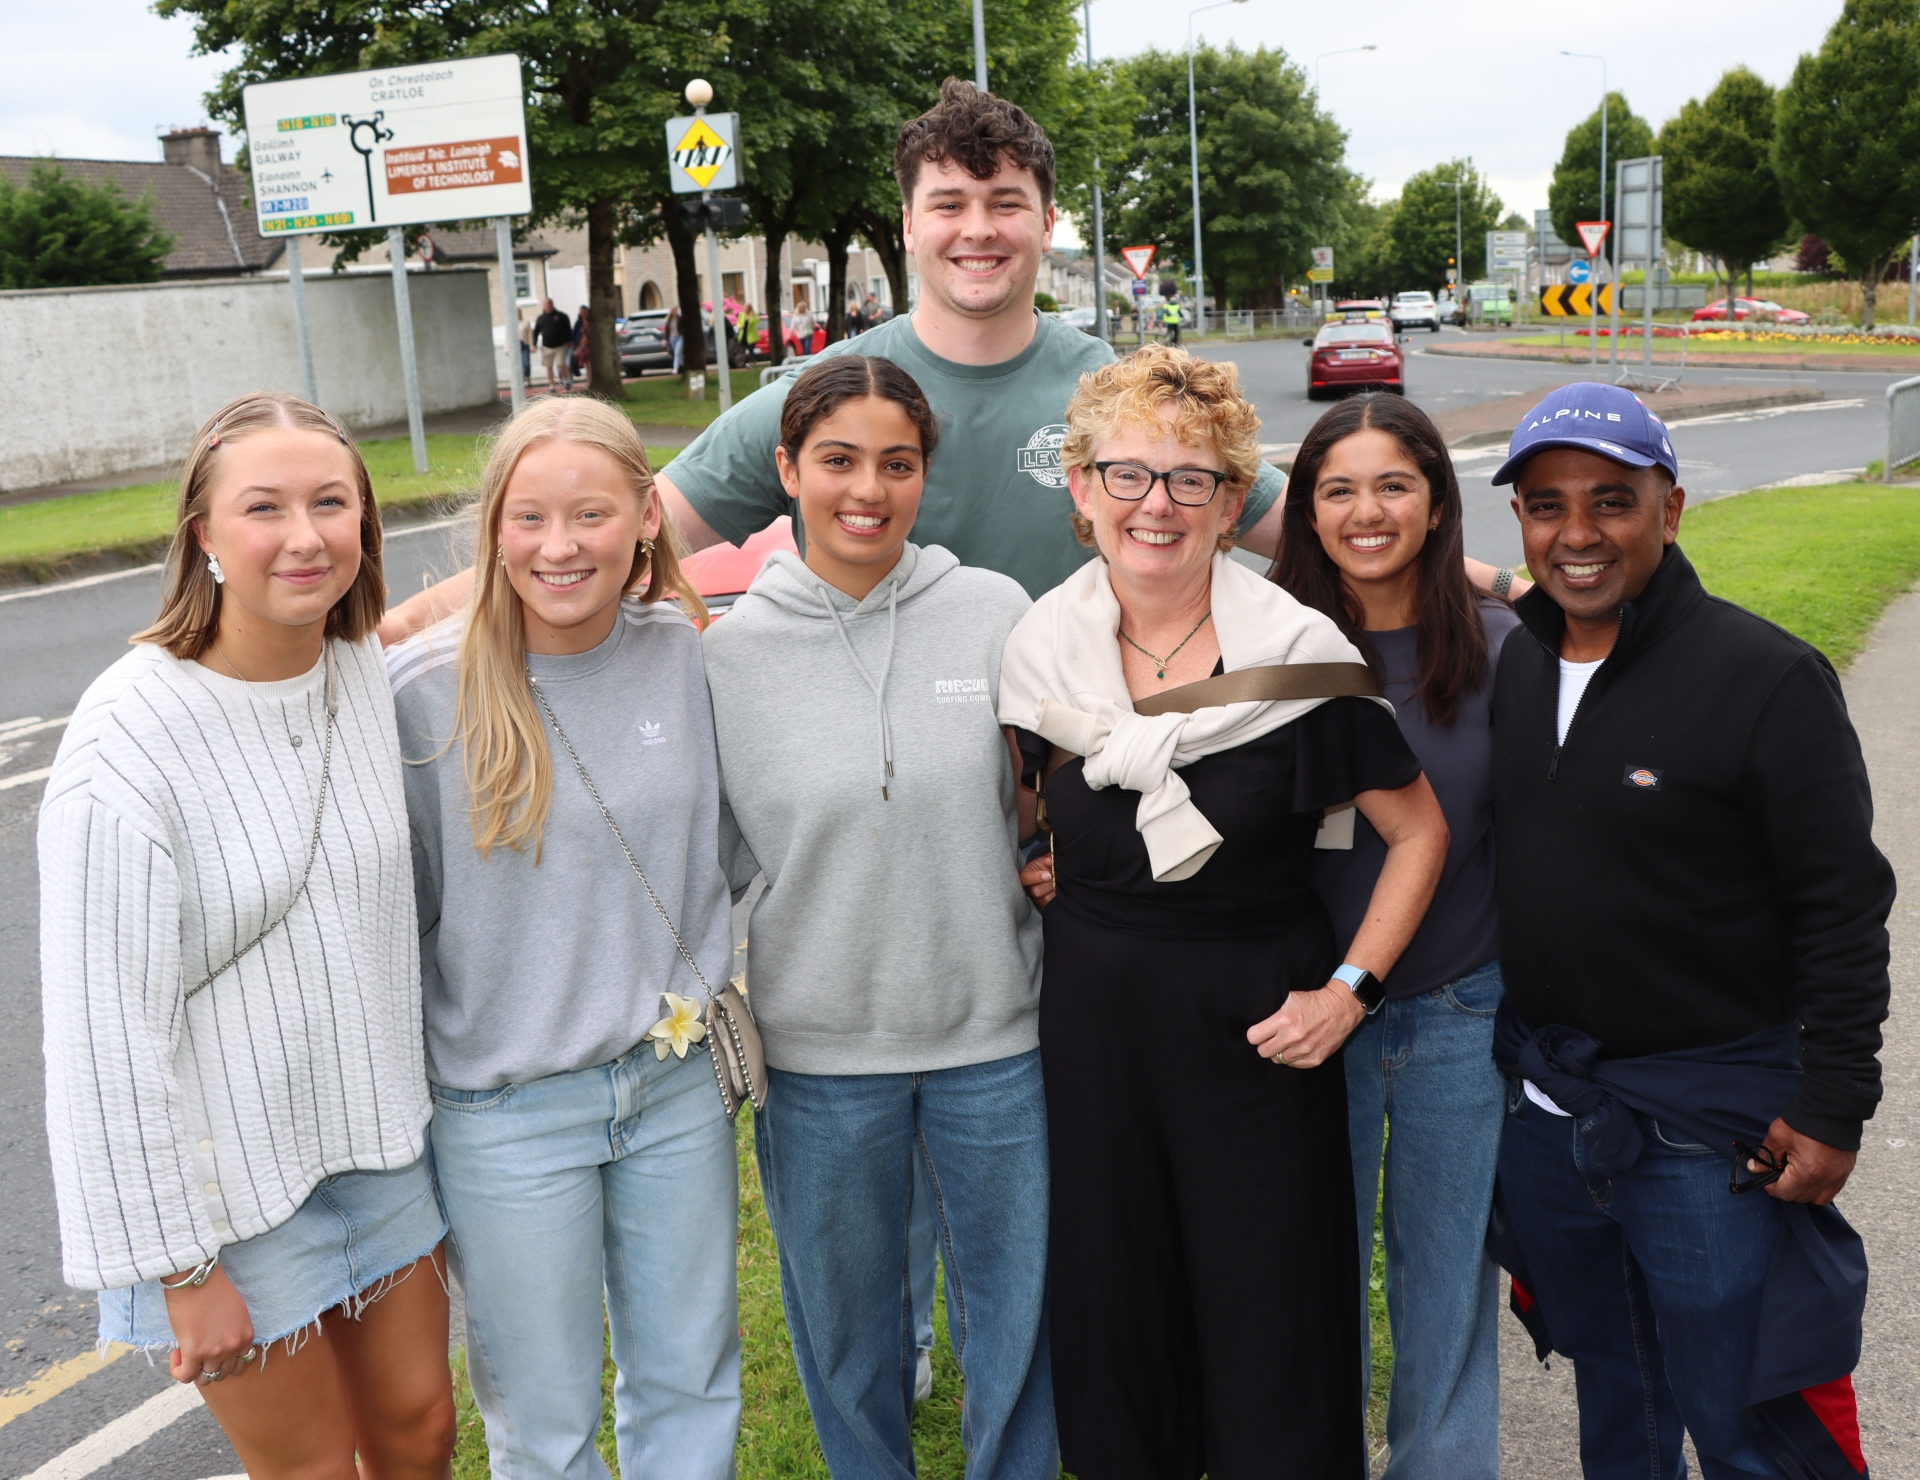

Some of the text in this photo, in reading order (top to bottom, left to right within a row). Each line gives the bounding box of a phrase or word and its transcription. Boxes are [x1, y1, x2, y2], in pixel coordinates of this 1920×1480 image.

[371, 86, 425, 102] CRATLOE
[254, 137, 295, 151] Gaillimh
[450, 143, 491, 159] Luimnigh
[255, 150, 302, 165] GALWAY
[388, 157, 488, 178] LIMERICK INSTITUTE
[413, 170, 496, 189] OF TECHNOLOGY
[260, 181, 318, 196] SHANNON
[1582, 226, 1604, 234] YIELD
[1129, 250, 1149, 258] YIELD
[1528, 409, 1622, 432] ALPINE
[936, 696, 968, 704] SURFING
[642, 736, 667, 746] adidas
